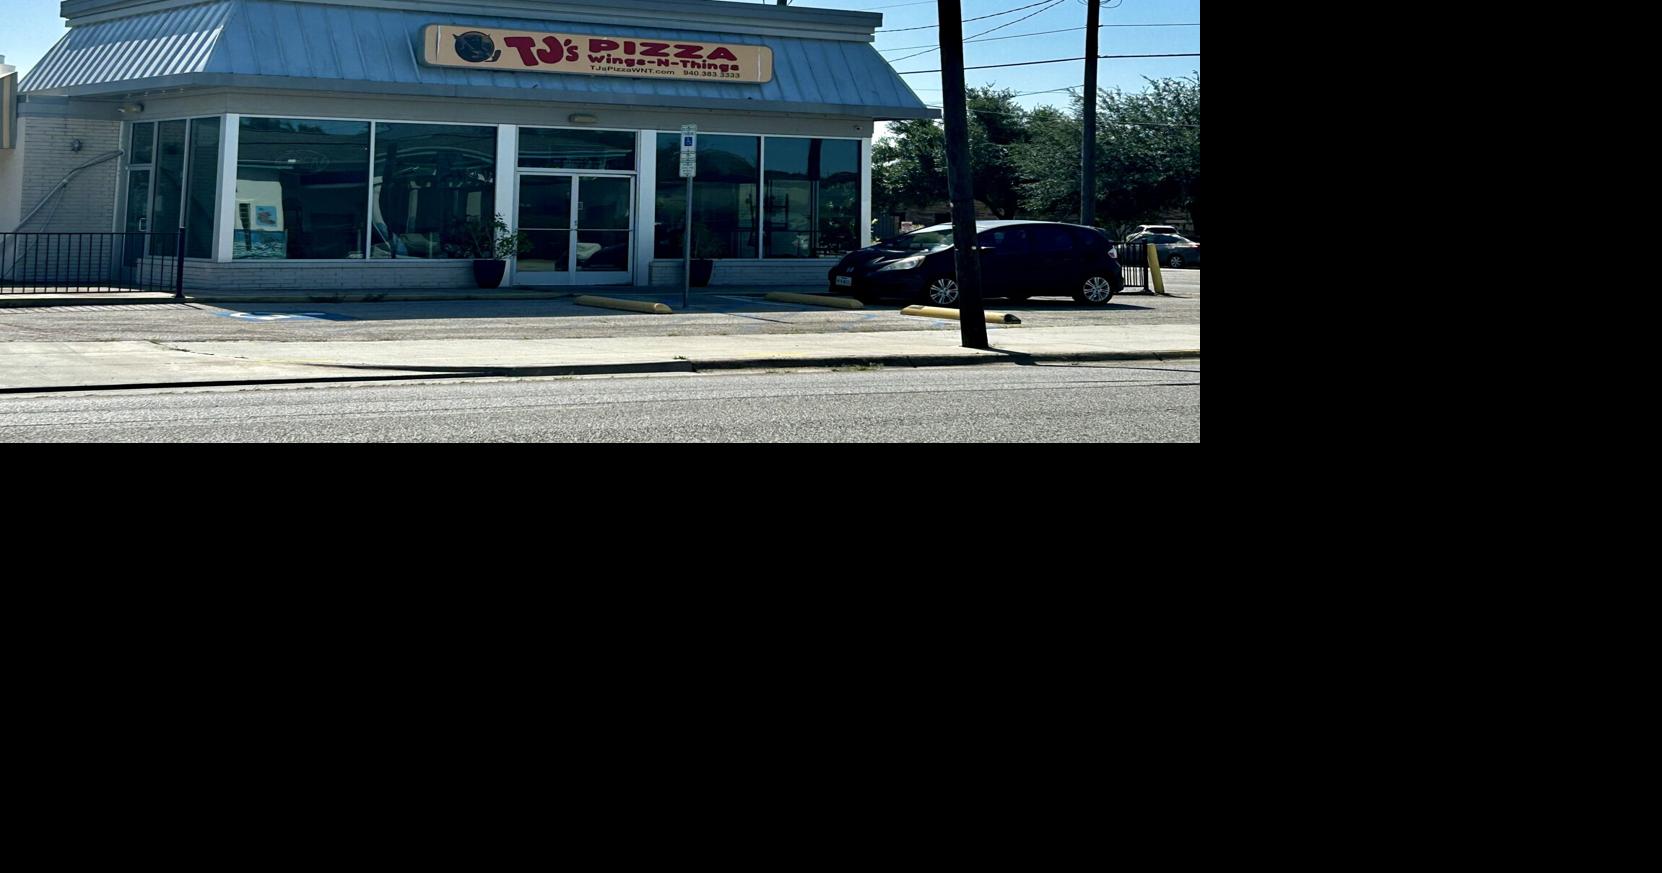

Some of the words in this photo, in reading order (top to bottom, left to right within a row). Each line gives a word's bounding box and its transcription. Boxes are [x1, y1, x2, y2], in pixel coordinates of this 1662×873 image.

[503, 36, 579, 66] TJ's
[588, 39, 738, 61] PIZZA
[587, 54, 739, 72] Wings-N-Things
